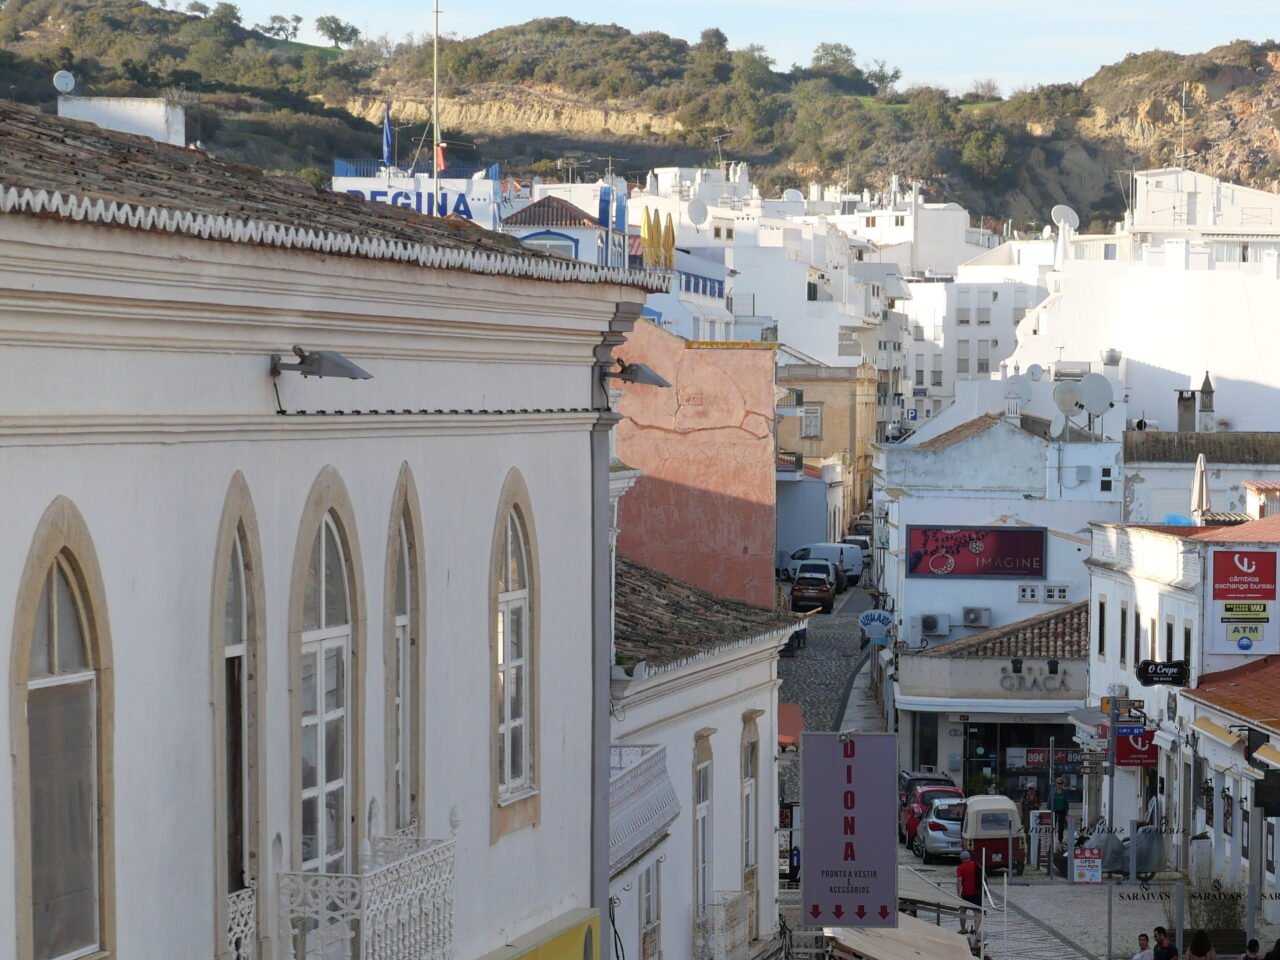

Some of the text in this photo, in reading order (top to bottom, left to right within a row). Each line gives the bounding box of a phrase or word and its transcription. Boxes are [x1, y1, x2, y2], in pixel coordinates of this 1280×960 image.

[976, 557, 1040, 569] IMAGINE
[1232, 626, 1258, 634] ATM
[1157, 664, 1178, 676] Crepe
[1027, 752, 1045, 762] 89€
[843, 739, 856, 861] DIONA
[821, 870, 877, 878] PRONTO A VESTIR
[847, 878, 851, 886] E
[1119, 891, 1170, 900] SARAIVA'S
[1191, 891, 1243, 900] SARAIVA'S
